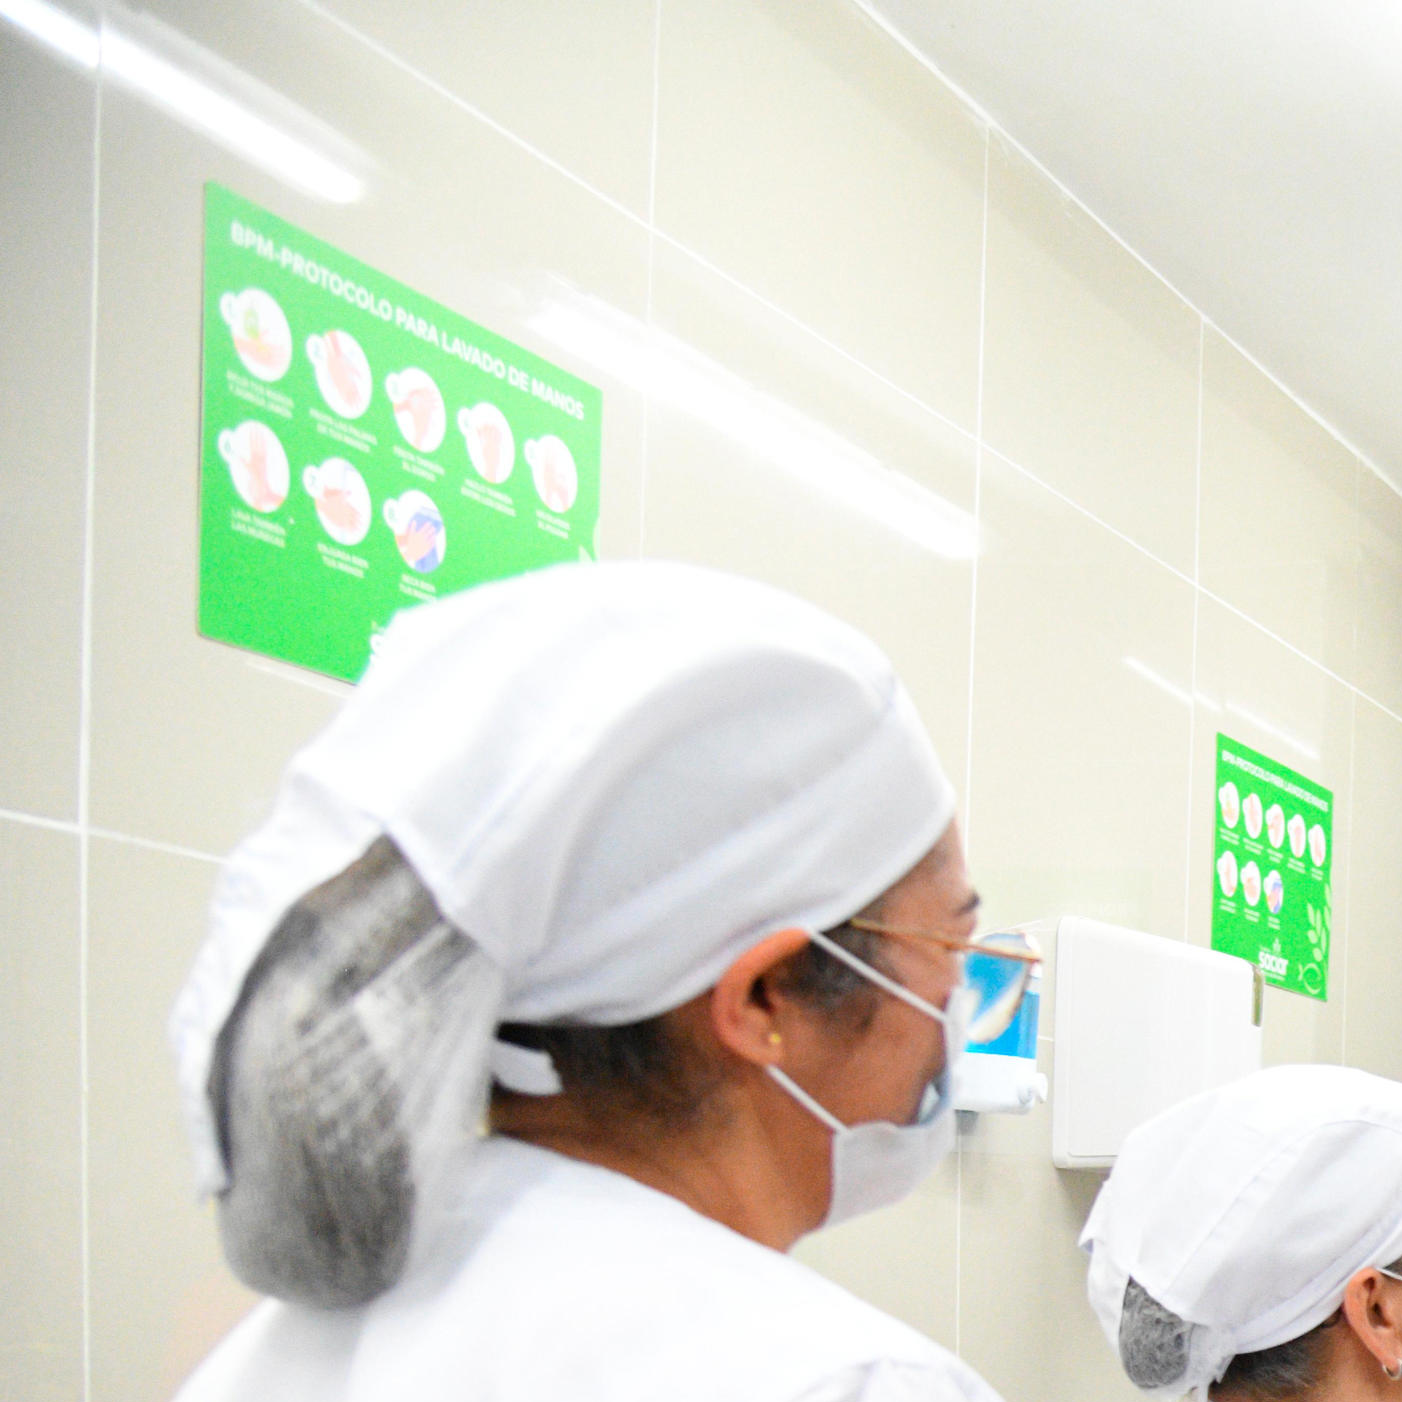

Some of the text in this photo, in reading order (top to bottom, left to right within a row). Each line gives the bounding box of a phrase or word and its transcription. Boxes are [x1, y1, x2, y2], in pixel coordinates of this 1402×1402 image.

[394, 307, 439, 347] PARA
[441, 329, 507, 380] LAVADO
[508, 358, 530, 389] DE
[531, 370, 585, 422] MANOS
